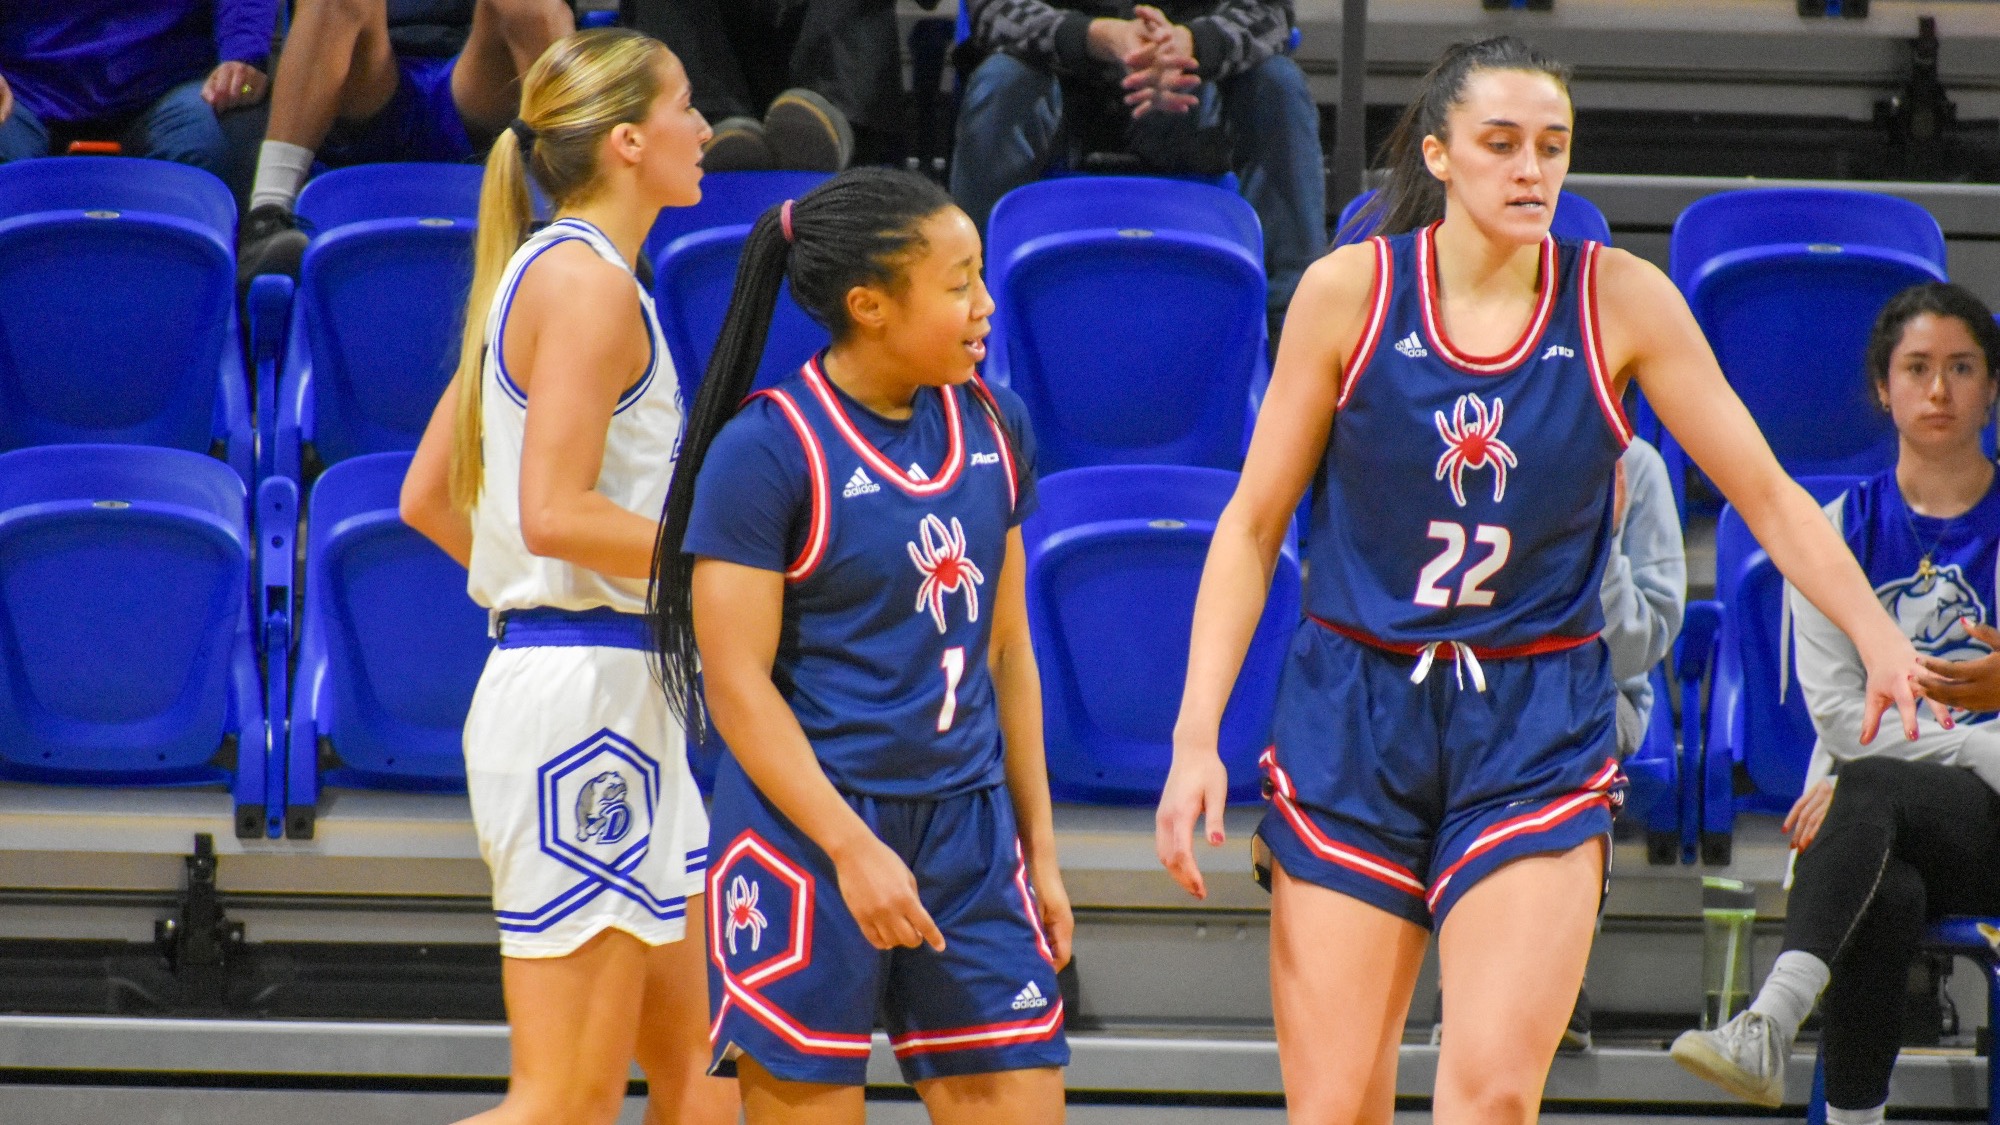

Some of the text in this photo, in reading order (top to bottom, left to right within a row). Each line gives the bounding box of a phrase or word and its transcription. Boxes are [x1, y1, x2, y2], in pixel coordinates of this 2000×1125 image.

[1394, 342, 1428, 358] adidas
[842, 483, 881, 499] adidas
[1413, 519, 1512, 607] 22
[936, 645, 965, 732] 1
[1011, 997, 1048, 1010] adidas
